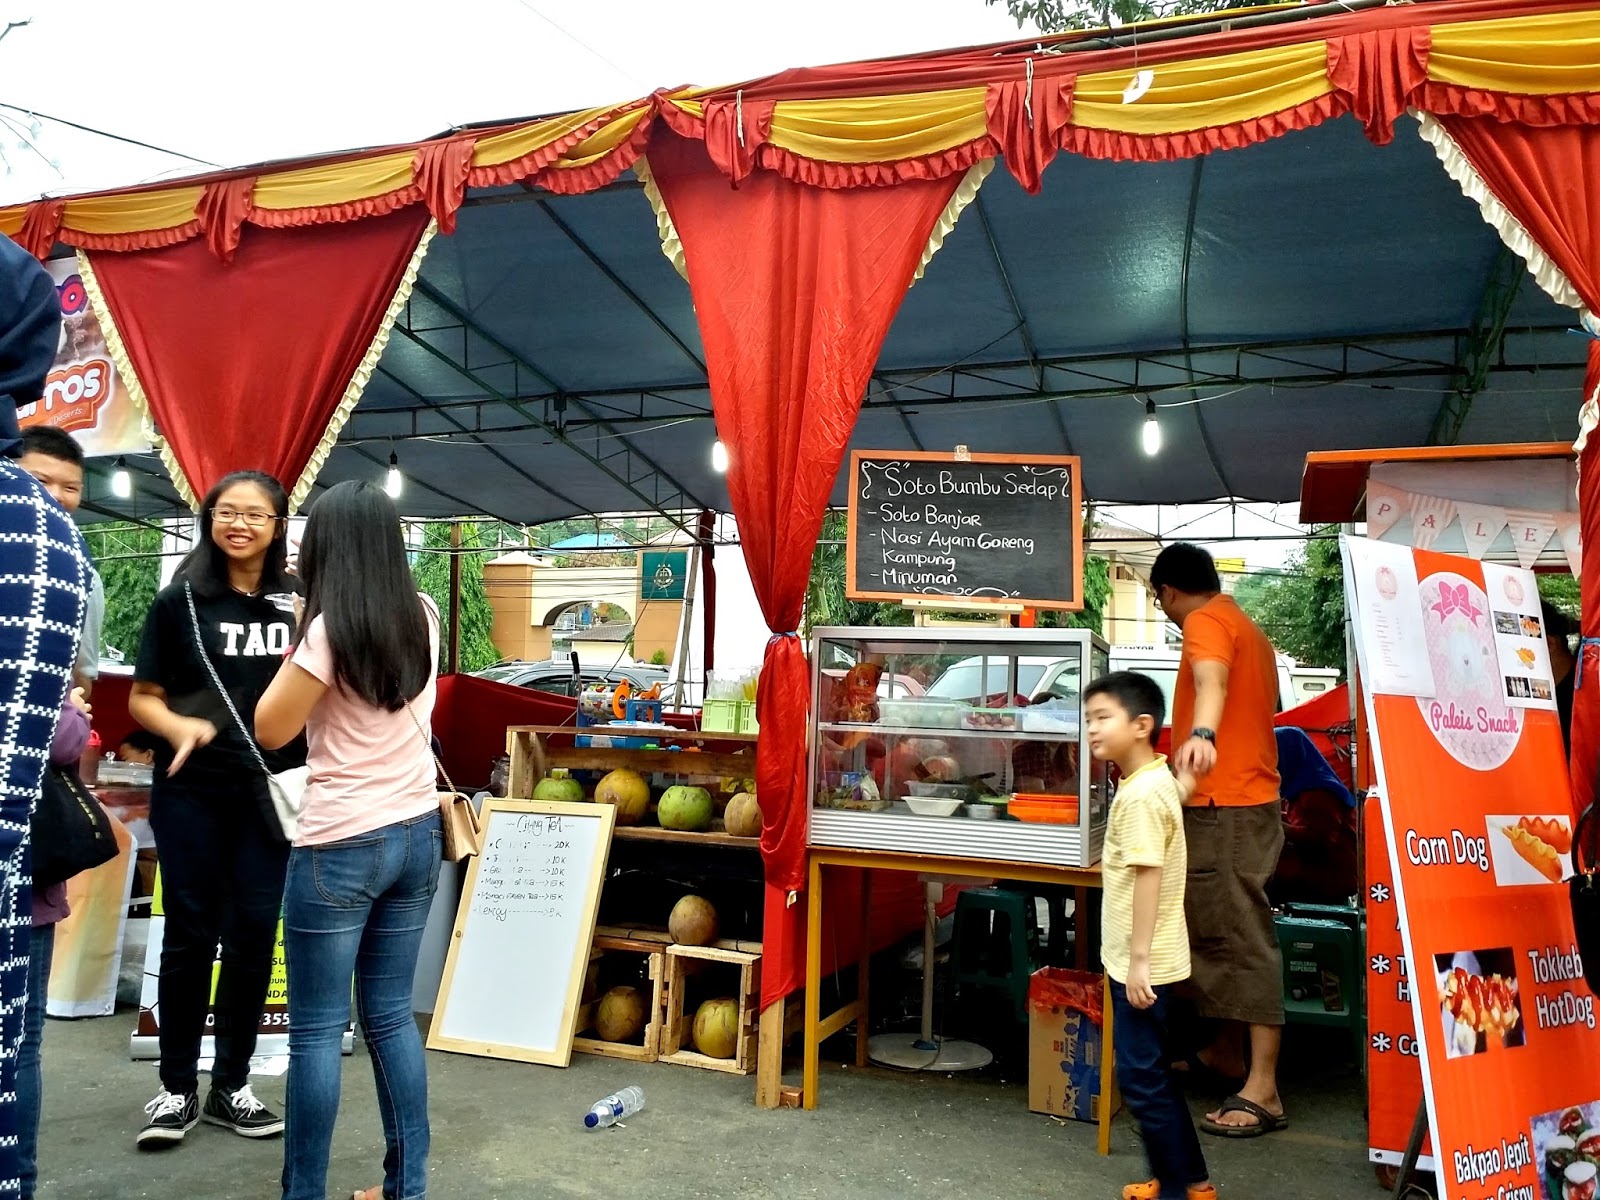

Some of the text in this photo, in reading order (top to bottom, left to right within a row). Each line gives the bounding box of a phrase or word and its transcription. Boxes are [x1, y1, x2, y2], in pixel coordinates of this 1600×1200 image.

[884, 467, 1058, 500] Soto Bumbu Sedap
[880, 502, 920, 523] Soto
[881, 527, 922, 546] Nasi
[928, 530, 975, 555] Ayam
[882, 548, 956, 571] Kampung
[882, 569, 958, 586] Minuman
[1430, 702, 1519, 734] Paleis Snack
[1405, 829, 1490, 872] Corn Dog
[1528, 944, 1584, 984] Tokkeb
[1535, 991, 1596, 1029] HotDog
[1454, 1132, 1531, 1186] Bakpao Jepit
